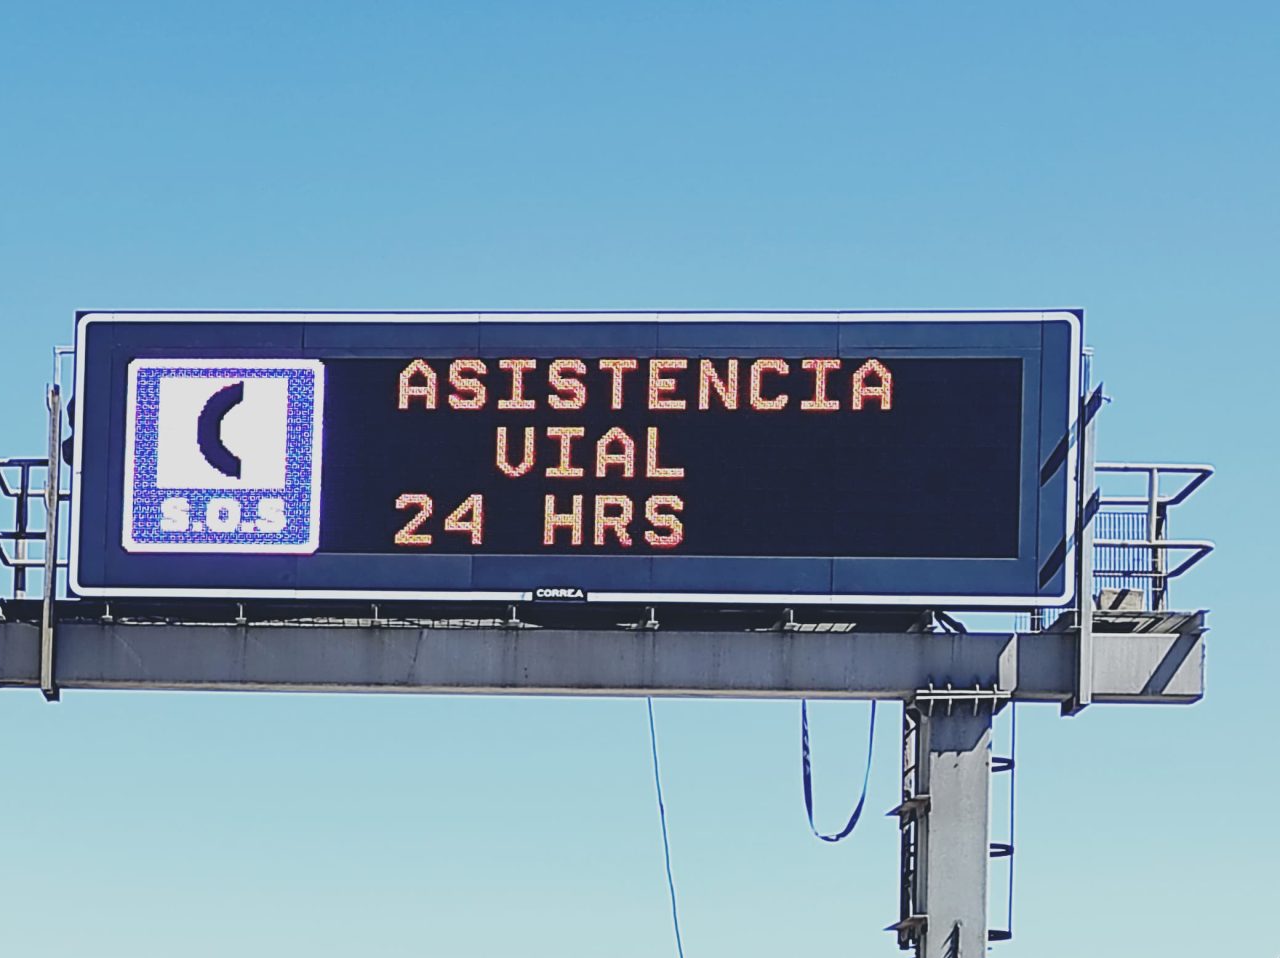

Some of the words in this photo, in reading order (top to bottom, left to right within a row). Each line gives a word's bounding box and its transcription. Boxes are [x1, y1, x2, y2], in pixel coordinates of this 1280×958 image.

[398, 358, 892, 411] ASISTENCIA
[496, 426, 686, 478] VIAL
[160, 497, 288, 533] S.O.S
[393, 494, 485, 546] 24
[542, 494, 685, 547] HRS
[536, 588, 584, 598] CORREA
